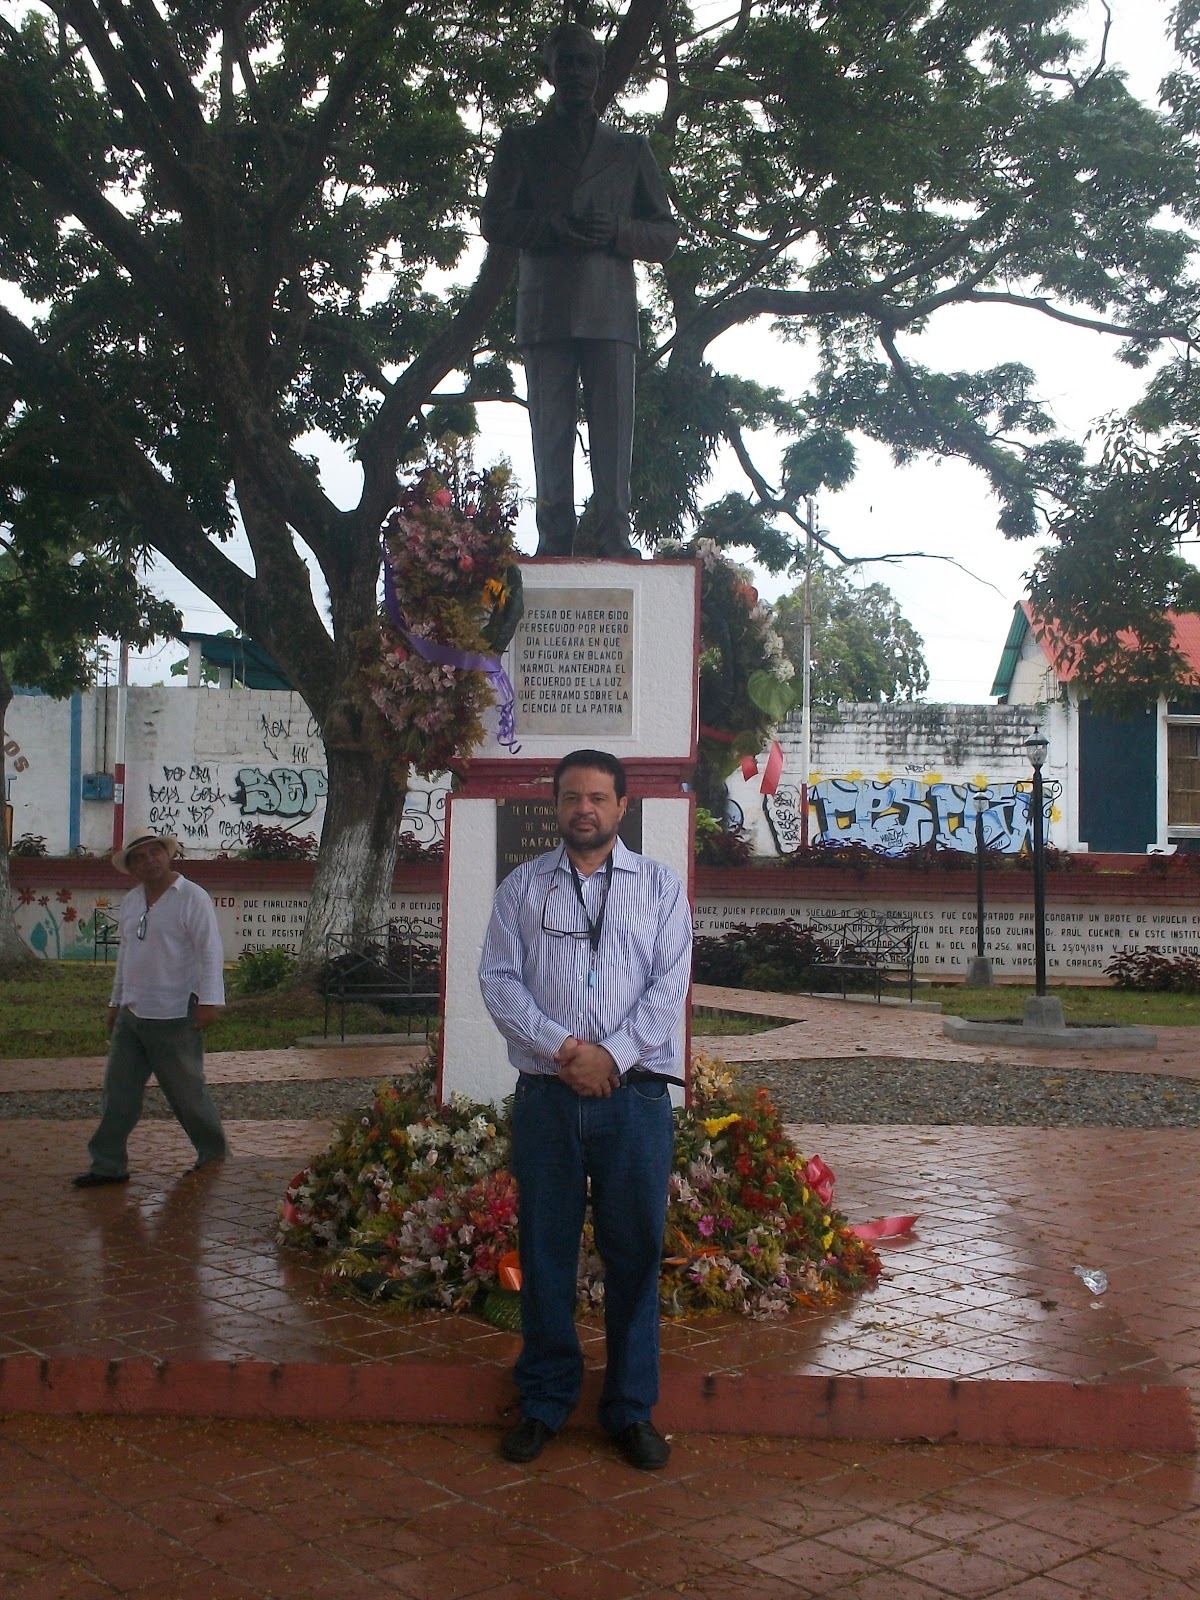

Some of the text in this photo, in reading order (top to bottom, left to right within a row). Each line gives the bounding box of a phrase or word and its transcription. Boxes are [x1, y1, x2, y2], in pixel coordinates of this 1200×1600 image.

[528, 610, 557, 619] PESAR
[560, 610, 572, 619] DE
[576, 611, 605, 620] HABER
[519, 623, 629, 634] PERSEGUIDO POR NEGRO
[526, 636, 621, 648] DIA LLEGARA EN QUE
[523, 650, 623, 660] SU FIGURA EN BLANCO
[519, 663, 626, 674] MARMOL MANTENDRA EL
[524, 676, 622, 687] RECUERDO DE LA LUZ
[518, 690, 629, 700] QUE DERRAMO SOBRE LA
[522, 703, 623, 713] CIENCIA DE LA PATRIA
[243, 900, 258, 909] QUE
[722, 906, 746, 917] QUIEN
[790, 908, 801, 916] UN
[961, 911, 1014, 921] CONRATADO
[1019, 912, 1035, 921] PAR
[1045, 913, 1084, 922] COMBATIR
[1089, 914, 1100, 922] UN
[1104, 914, 1131, 923] BROTE
[1136, 915, 1147, 924] DE
[1152, 915, 1187, 924] VIRUELA
[243, 915, 253, 923] EN
[257, 915, 267, 923] EL
[694, 921, 705, 929] SE
[939, 926, 954, 935] DEL
[1006, 927, 1035, 936] ZULIAN
[1129, 930, 1140, 938] EN
[1145, 929, 1165, 938] ESTE
[242, 929, 252, 937] EN
[257, 929, 266, 937] EL
[271, 929, 305, 938] REGISTR
[919, 941, 929, 949] EL
[950, 942, 965, 950] DEL
[971, 942, 992, 950] ATA
[1016, 943, 1035, 951] NACI
[1045, 943, 1056, 952] EL
[935, 956, 945, 964] EN
[951, 956, 961, 965] EL
[1011, 957, 1037, 966] VARGA
[1049, 959, 1060, 967] EN
